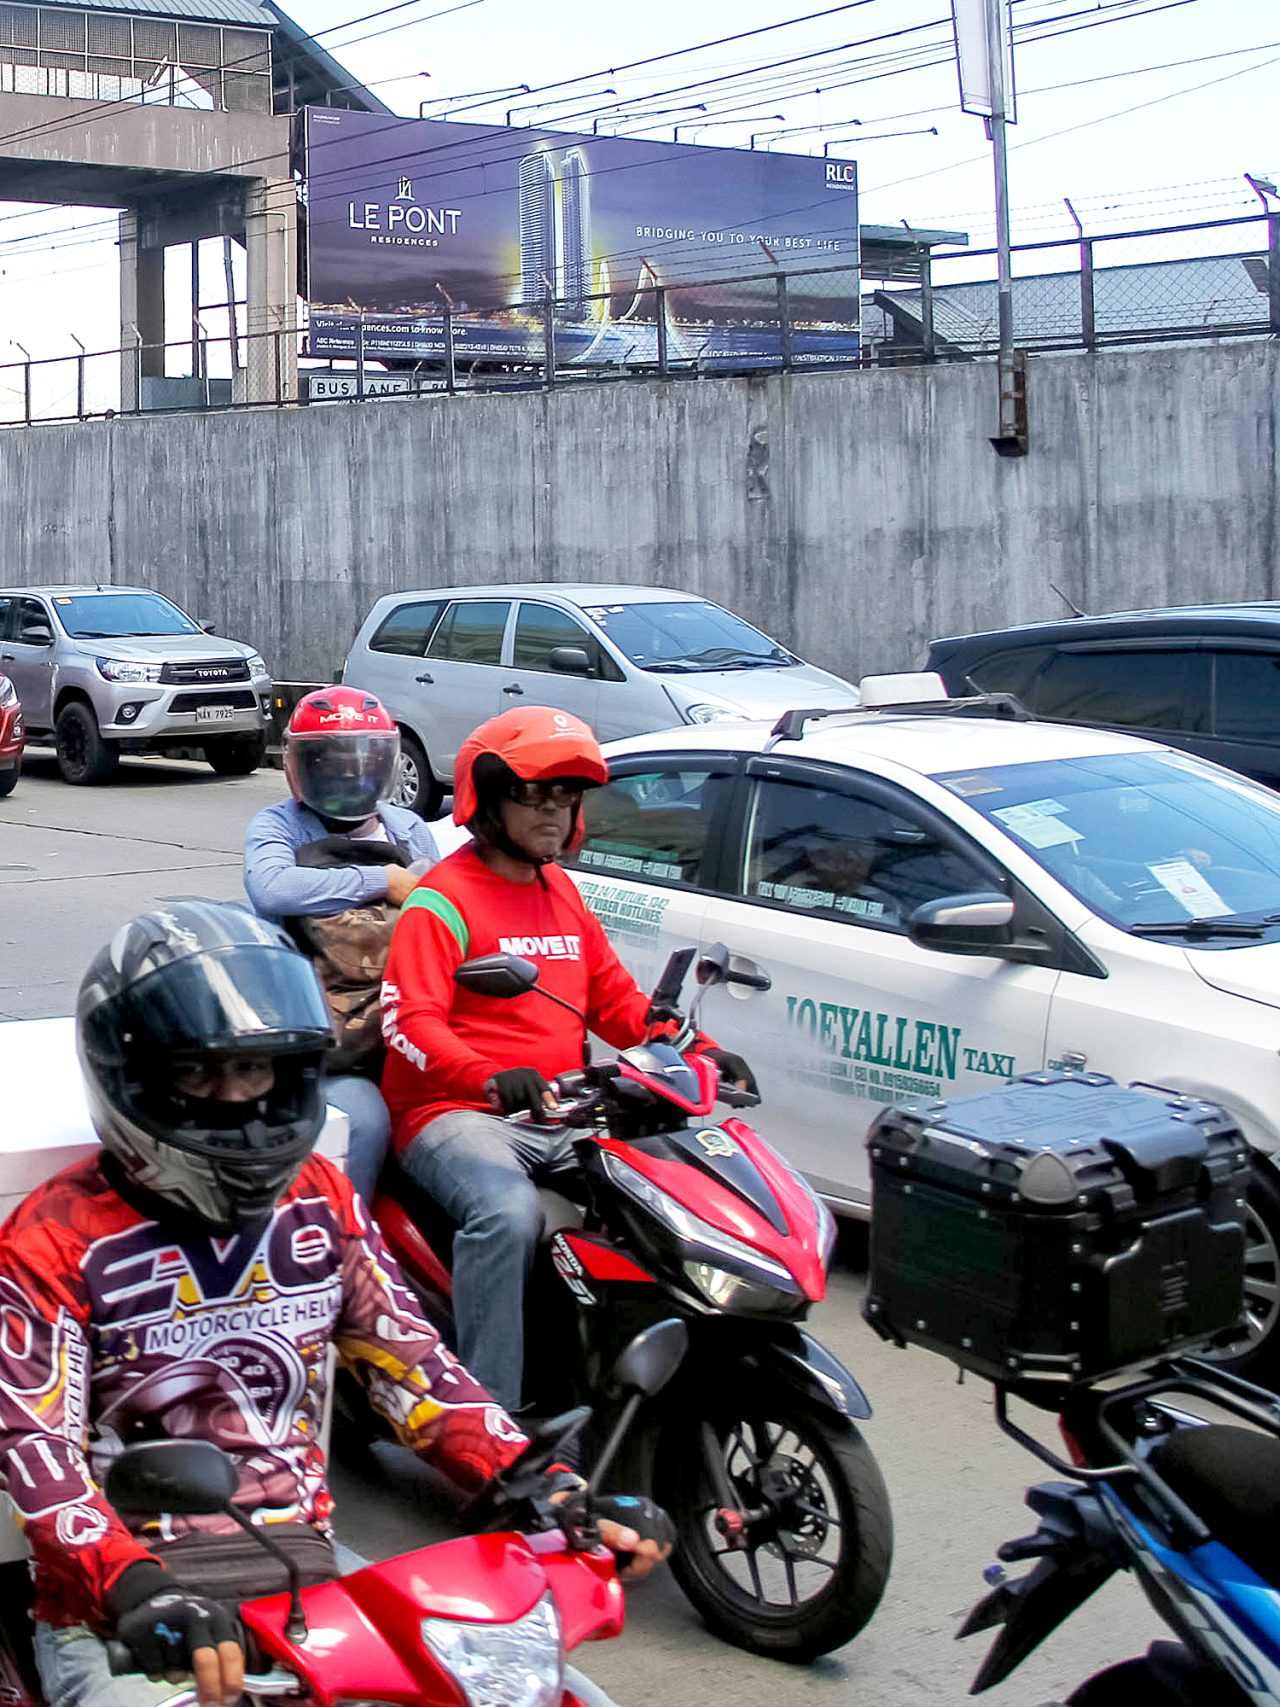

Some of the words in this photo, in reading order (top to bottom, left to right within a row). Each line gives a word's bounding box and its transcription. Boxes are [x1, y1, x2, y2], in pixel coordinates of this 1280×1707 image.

[826, 164, 853, 182] RLC
[349, 202, 380, 229] LE
[389, 205, 461, 234] PONT
[371, 236, 438, 246] RESIDENCES
[636, 226, 695, 241] BRIDGING
[701, 231, 723, 242] YOU
[729, 233, 744, 243] TO
[785, 237, 811, 248] BEST
[317, 383, 349, 395] BUS
[369, 384, 401, 395] ANE
[198, 669, 227, 677] TOYOTA
[215, 708, 233, 719] 7925
[320, 712, 363, 724] MOVE
[367, 714, 378, 724] IT
[963, 1047, 1016, 1078] TAXI
[149, 1306, 289, 1350] MOTORCYCLE
